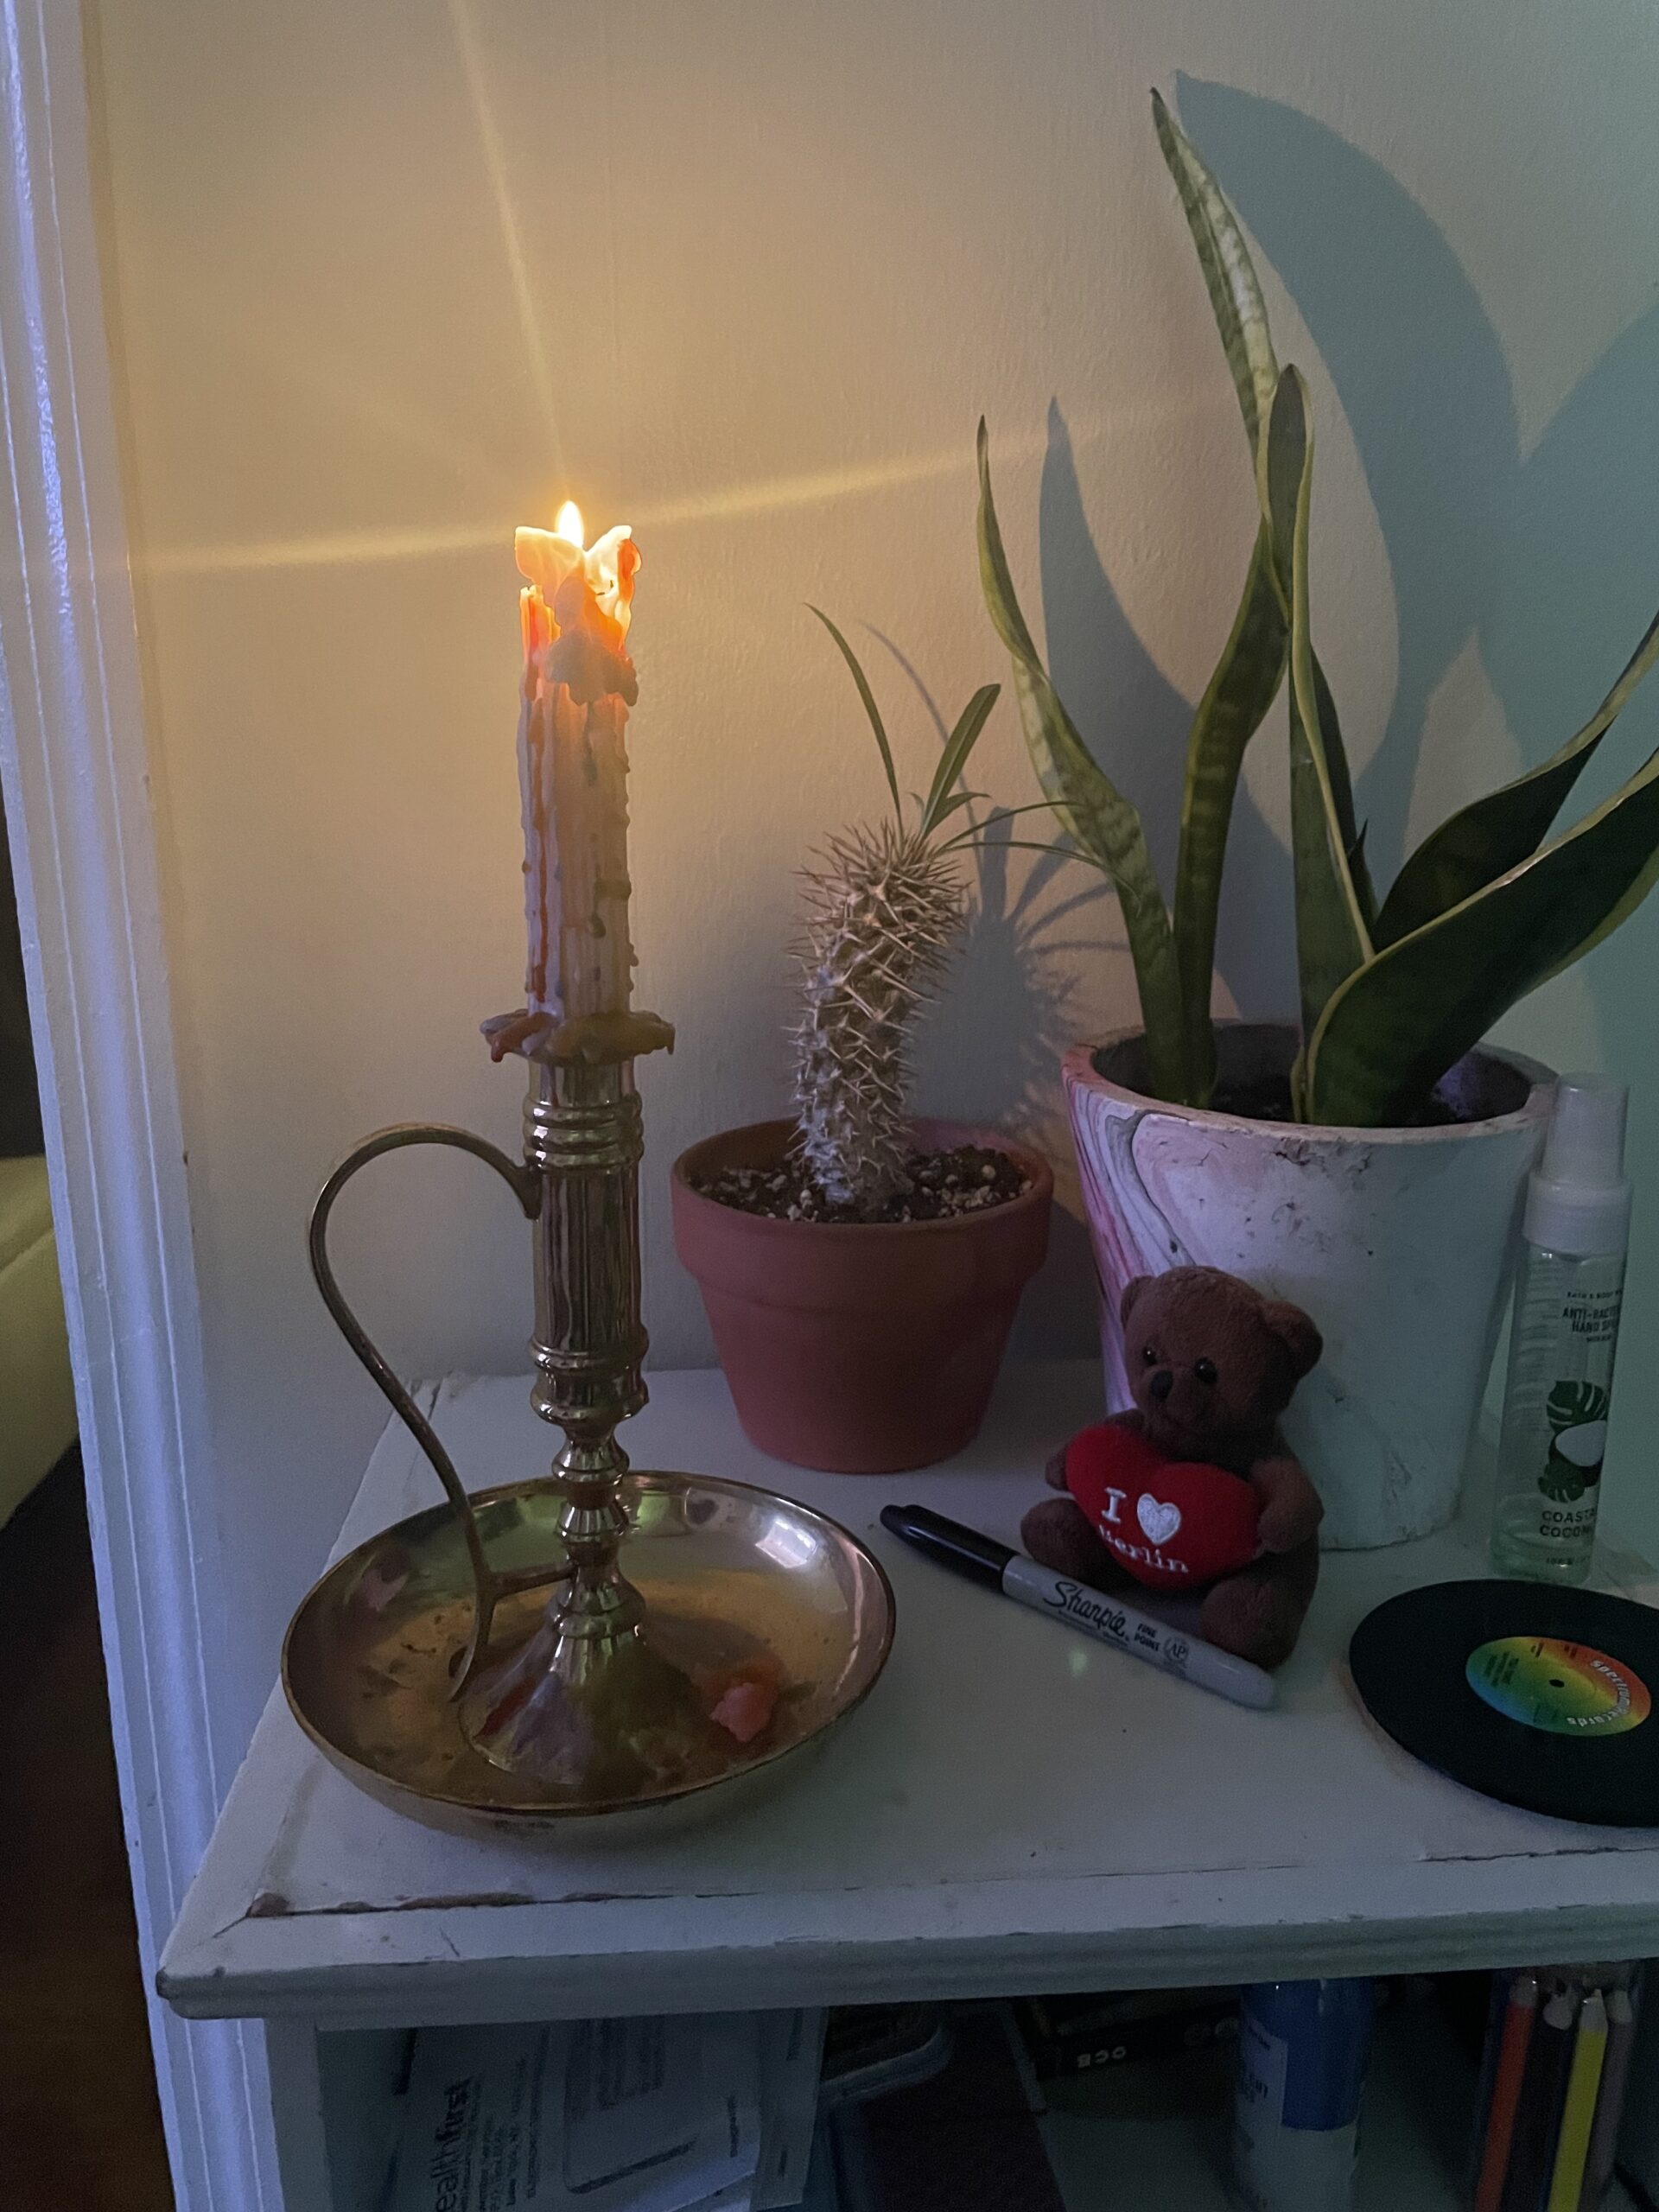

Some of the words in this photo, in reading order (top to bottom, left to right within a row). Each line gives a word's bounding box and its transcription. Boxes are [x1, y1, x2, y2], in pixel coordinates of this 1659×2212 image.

[1572, 1320, 1599, 1332] HAND
[1101, 1485, 1128, 1524] I
[1043, 1580, 1128, 1637] Sharpie
[1136, 1623, 1158, 1637] FINE
[1134, 1634, 1161, 1652] POINT
[1077, 2045, 1128, 2069] OCB
